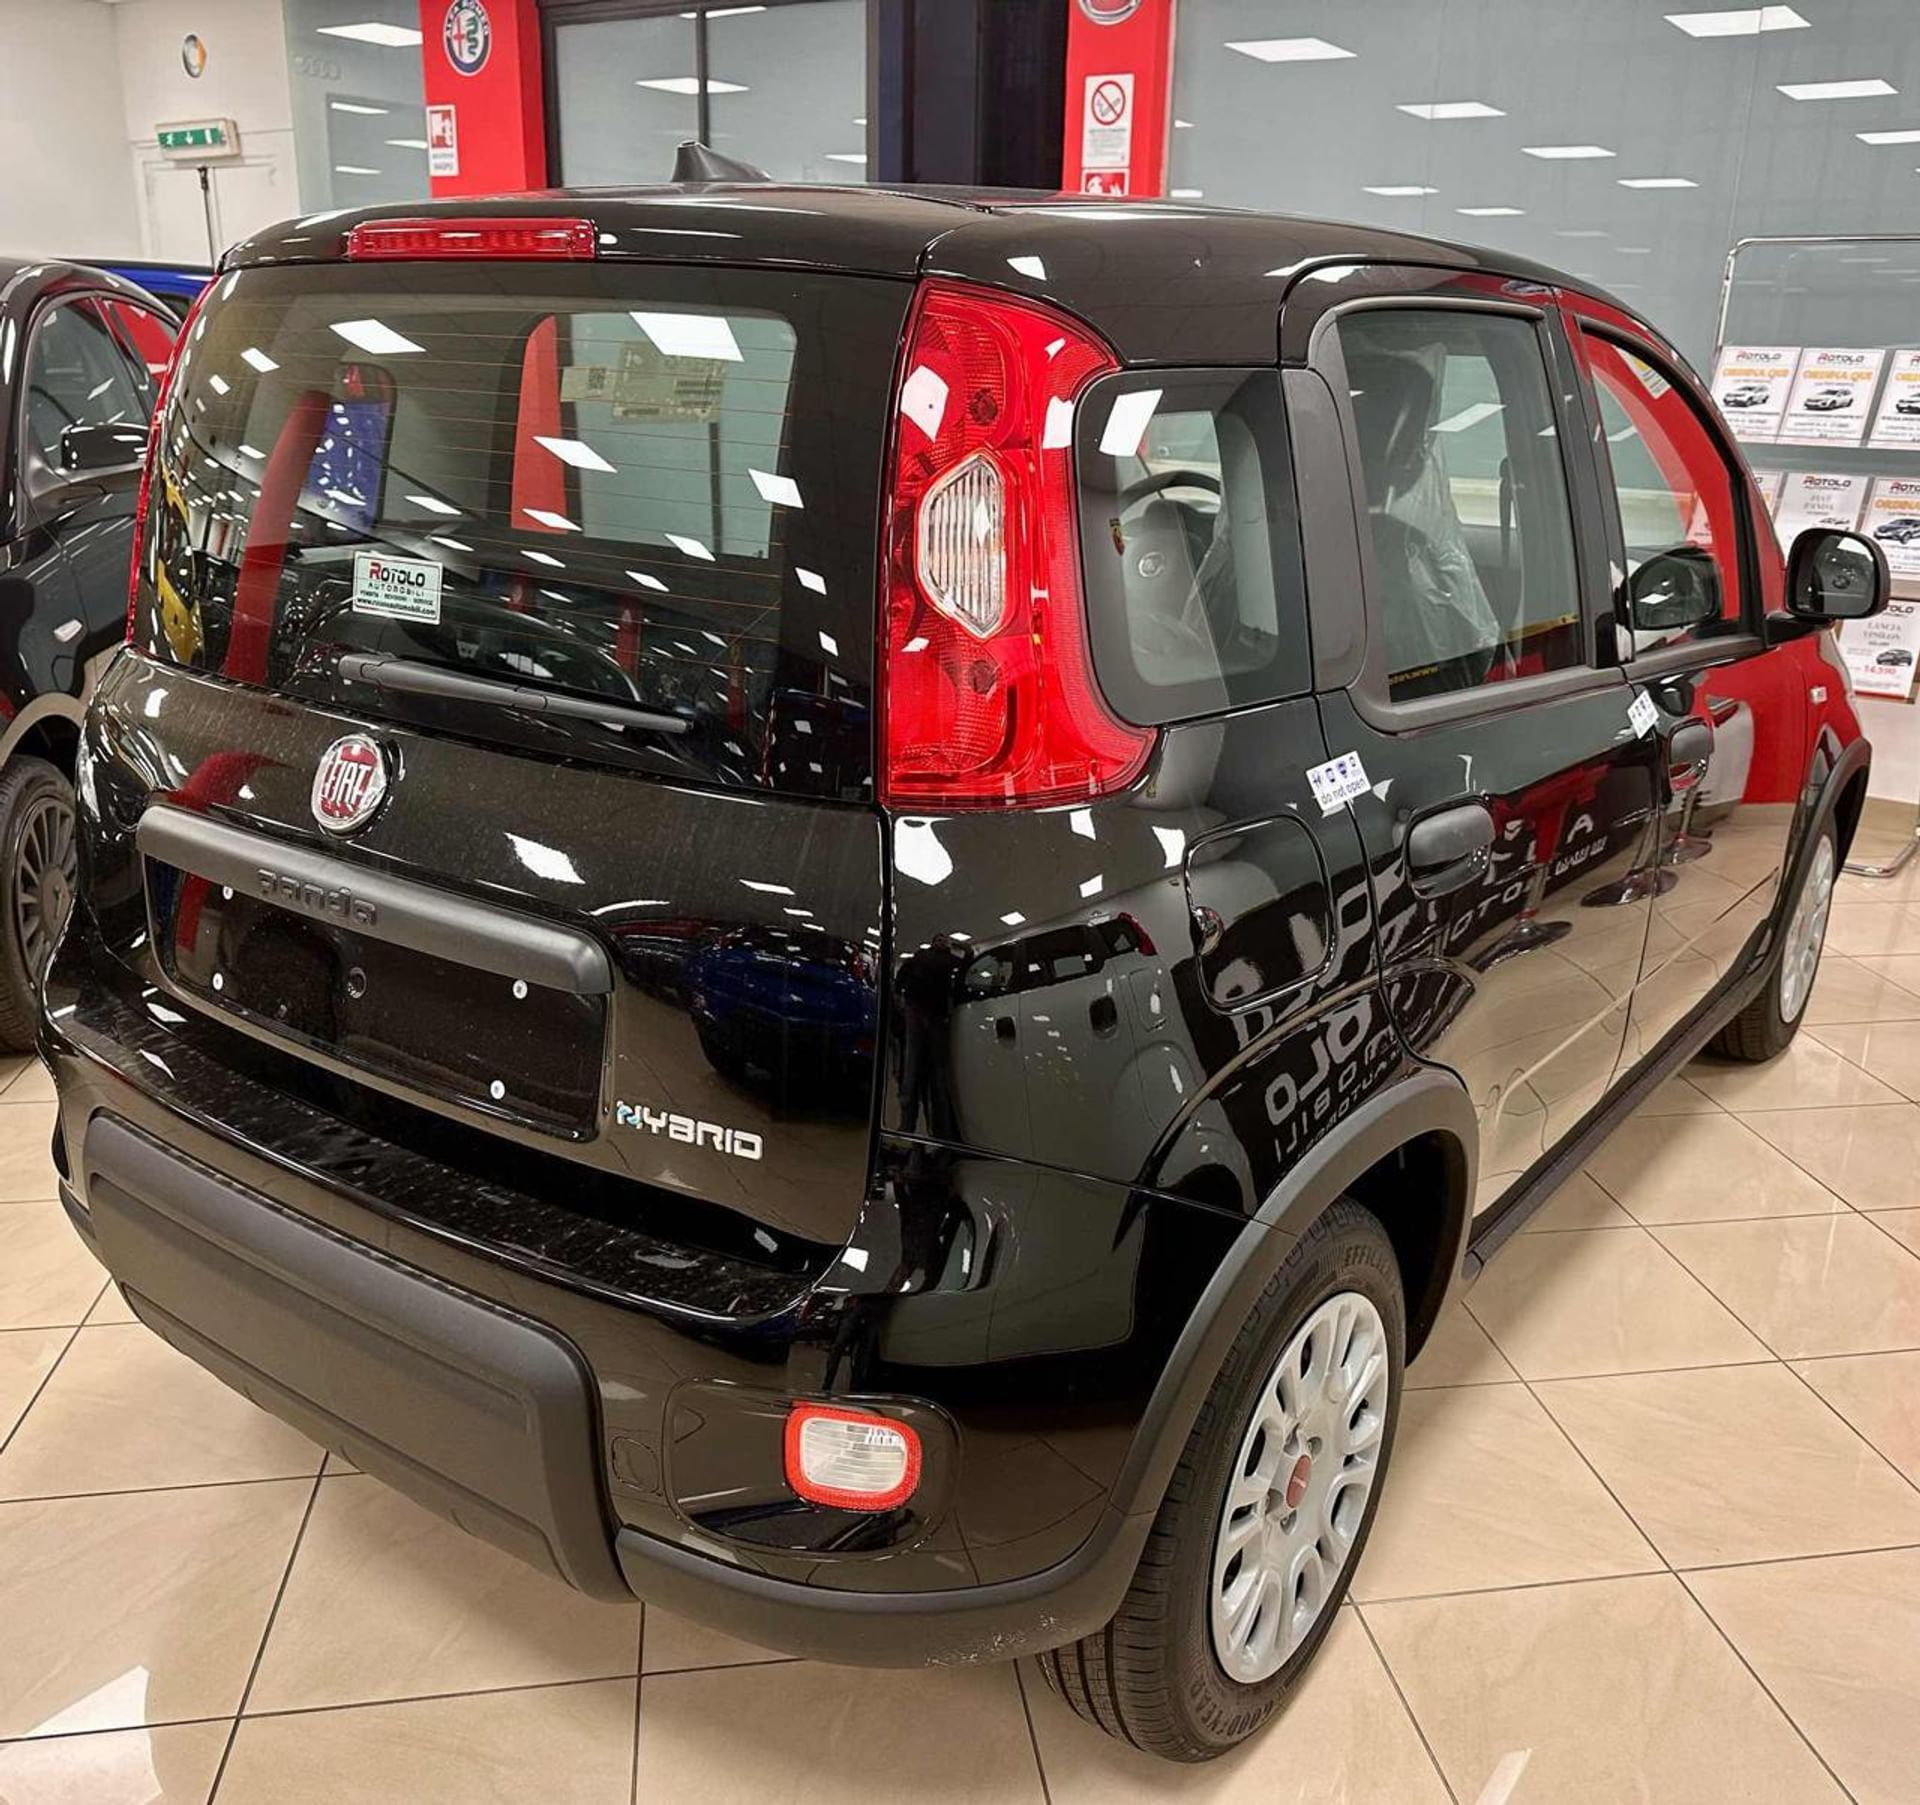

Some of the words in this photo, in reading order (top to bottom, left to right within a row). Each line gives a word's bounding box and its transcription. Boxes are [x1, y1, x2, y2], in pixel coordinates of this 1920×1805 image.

[1736, 351, 1782, 362] ROTOLO
[1817, 353, 1865, 364] ROTOLO
[1803, 475, 1852, 488] ROTOLO
[369, 562, 426, 587] ROTOLO
[368, 582, 425, 597] AUTOMOBILI
[616, 1100, 763, 1160] HYBRID
[1190, 1676, 1274, 1737] GOODYEAR
